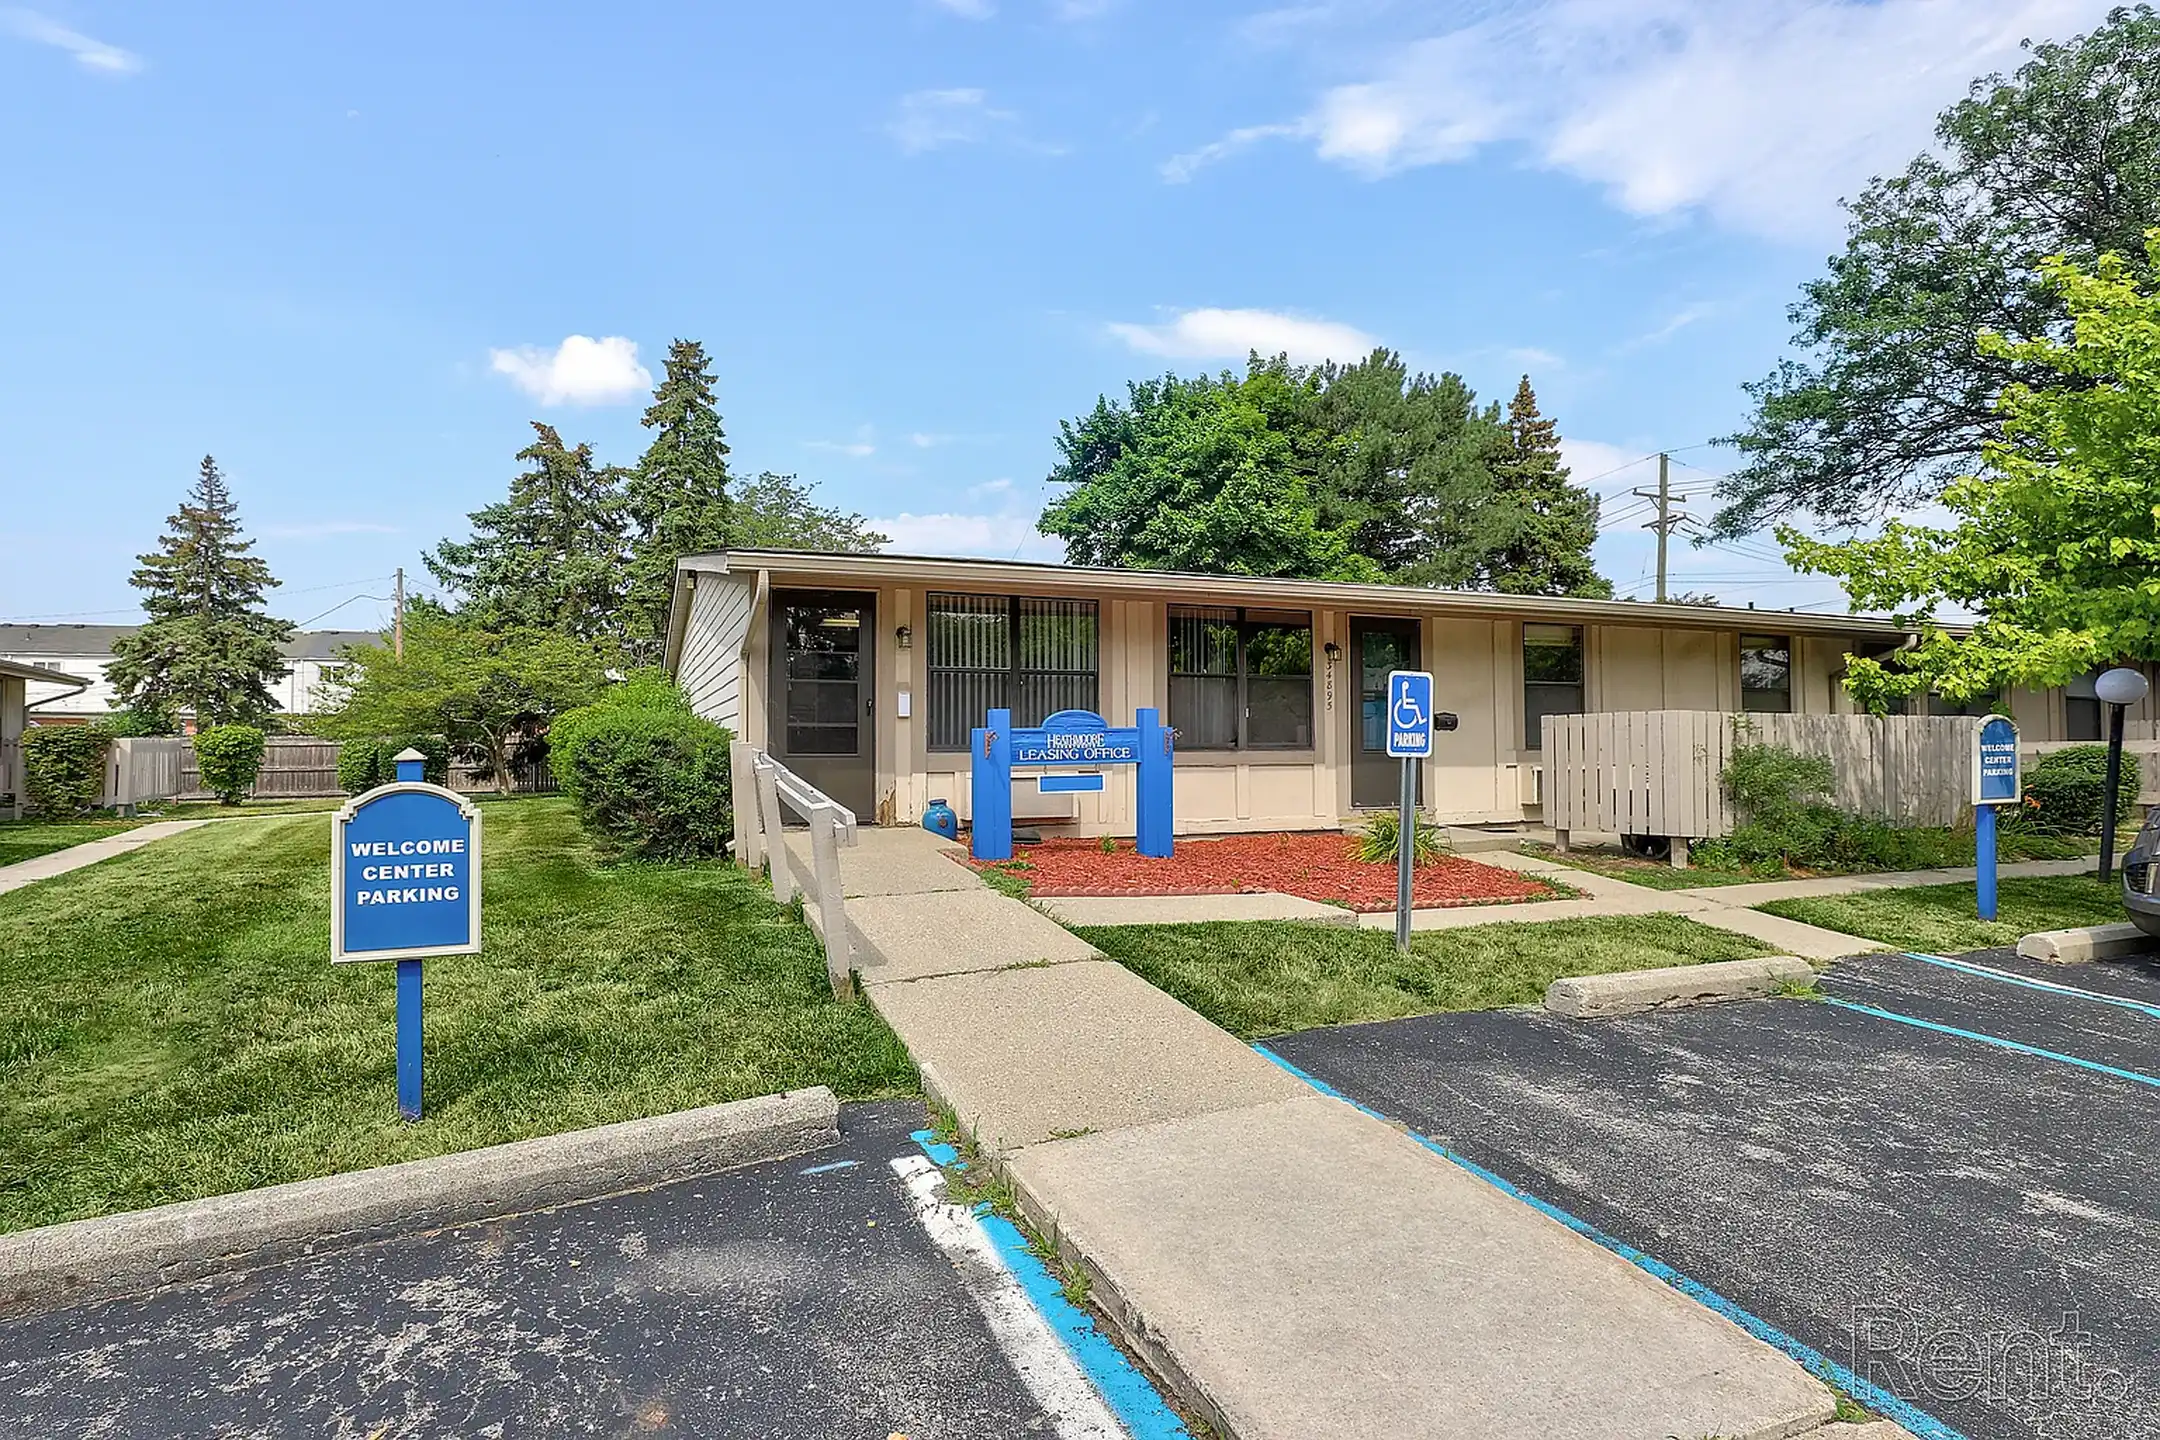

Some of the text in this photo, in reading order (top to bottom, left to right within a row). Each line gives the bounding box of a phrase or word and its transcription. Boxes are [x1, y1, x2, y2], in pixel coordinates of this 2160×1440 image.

[1393, 732, 1426, 748] PARKING
[1019, 748, 1131, 761] LEASING OFFICE
[1981, 744, 2015, 752] WELCOME
[1984, 756, 2012, 764] CENTER
[1982, 768, 2013, 776] PARKING
[351, 839, 465, 857] WELCOME
[362, 863, 454, 881] CENTER
[357, 886, 459, 905] PARKING
